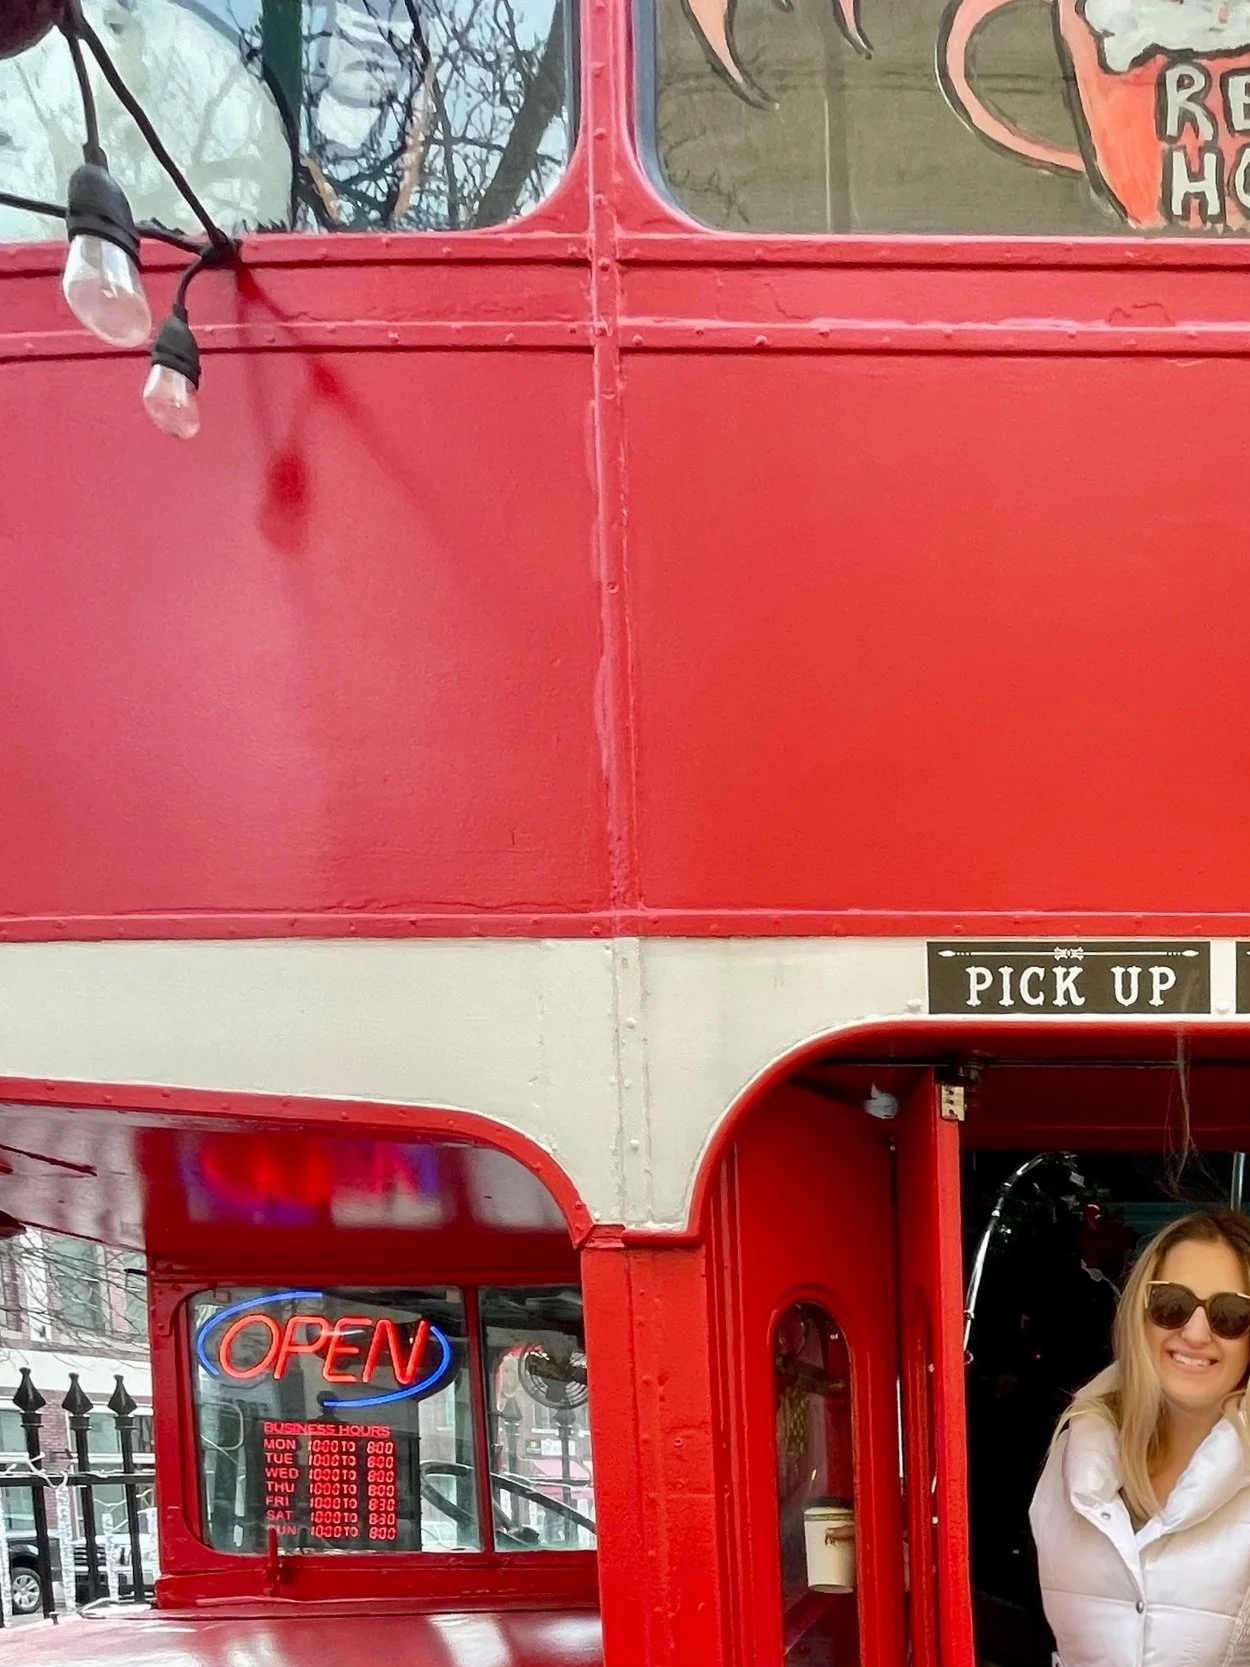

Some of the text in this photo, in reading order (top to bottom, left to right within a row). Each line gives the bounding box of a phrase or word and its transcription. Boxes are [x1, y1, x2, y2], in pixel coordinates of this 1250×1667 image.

[966, 966, 1177, 1007] PICK UP
[219, 1313, 429, 1385] OPEN
[264, 1422, 391, 1437] BUSINESS HOURS
[264, 1439, 296, 1449] MON
[341, 1441, 356, 1452] TO
[265, 1453, 293, 1464] TUE
[341, 1455, 356, 1466] TO
[265, 1468, 299, 1479] WED
[342, 1470, 357, 1480] TO
[266, 1481, 295, 1492] THU
[342, 1484, 357, 1494] TO
[265, 1496, 289, 1506] FRI
[342, 1498, 358, 1509] TO
[266, 1510, 293, 1520] SAT
[343, 1513, 358, 1523] TO
[344, 1527, 359, 1537] TO
